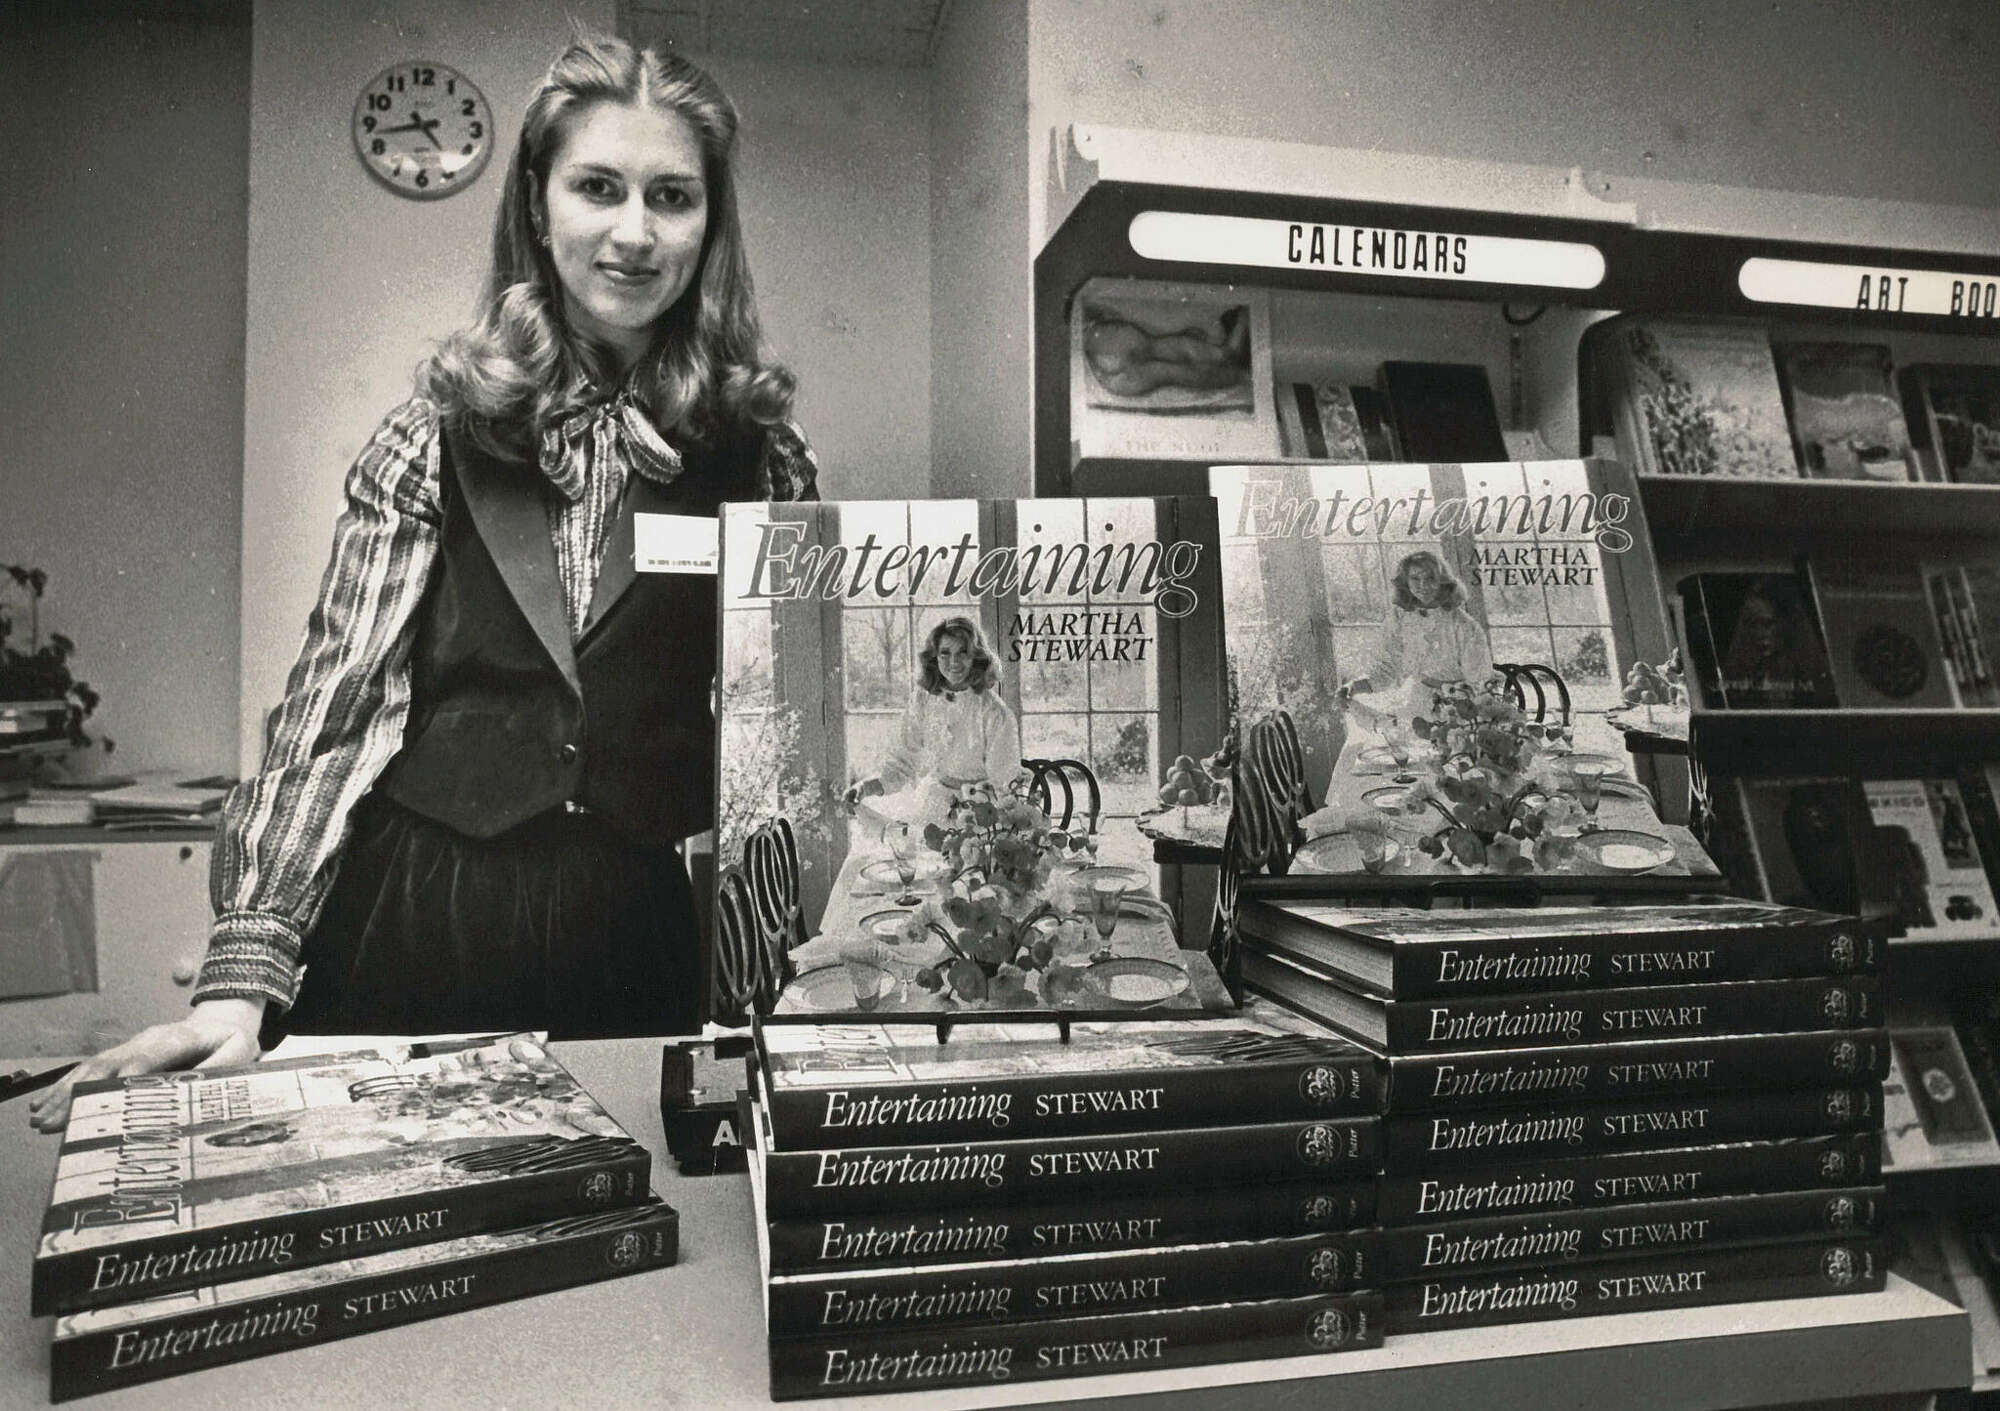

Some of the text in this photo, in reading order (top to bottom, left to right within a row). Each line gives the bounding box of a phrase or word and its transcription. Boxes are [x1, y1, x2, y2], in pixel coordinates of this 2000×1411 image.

[387, 76, 405, 92] 11
[413, 68, 435, 86] 12
[447, 79, 455, 95] 1
[369, 94, 391, 111] 10
[461, 99, 475, 116] 2
[363, 115, 377, 133] 9
[469, 121, 483, 139] 3
[372, 138, 385, 155] 8
[415, 169, 429, 187] 6
[1288, 224, 1467, 274] CALENDARS
[1857, 274, 1909, 312] ART
[1228, 479, 1634, 553] Entertaining
[737, 520, 1203, 620] Entertaining
[1469, 547, 1588, 566] MARTHA
[1470, 567, 1598, 587] STEWART
[1009, 612, 1145, 637] MARTHA
[1009, 637, 1153, 663] STEWART
[1436, 947, 1716, 984] Entertaining STEWART
[1426, 1003, 1708, 1041] Entertaining STEWART
[1432, 1059, 1715, 1096] Entertaining STEWART
[821, 1085, 1165, 1129] Entertaining STEWART
[1429, 1109, 1709, 1151] Entertaining STEWART
[813, 1145, 1160, 1188] Entertaining STEWART
[1415, 1172, 1702, 1214] Entertaining STEWART
[89, 1209, 449, 1293] Entertaining STEWART
[817, 1217, 1162, 1260] Entertaining STEWART
[1422, 1220, 1709, 1266] Entertaining STEWART
[820, 1277, 1166, 1326] Entertaining STEWART
[1419, 1271, 1706, 1317] Entertaining STEWART
[108, 1275, 476, 1370] Entertaining STEWART
[819, 1337, 1168, 1386] Entertaining STEWART
